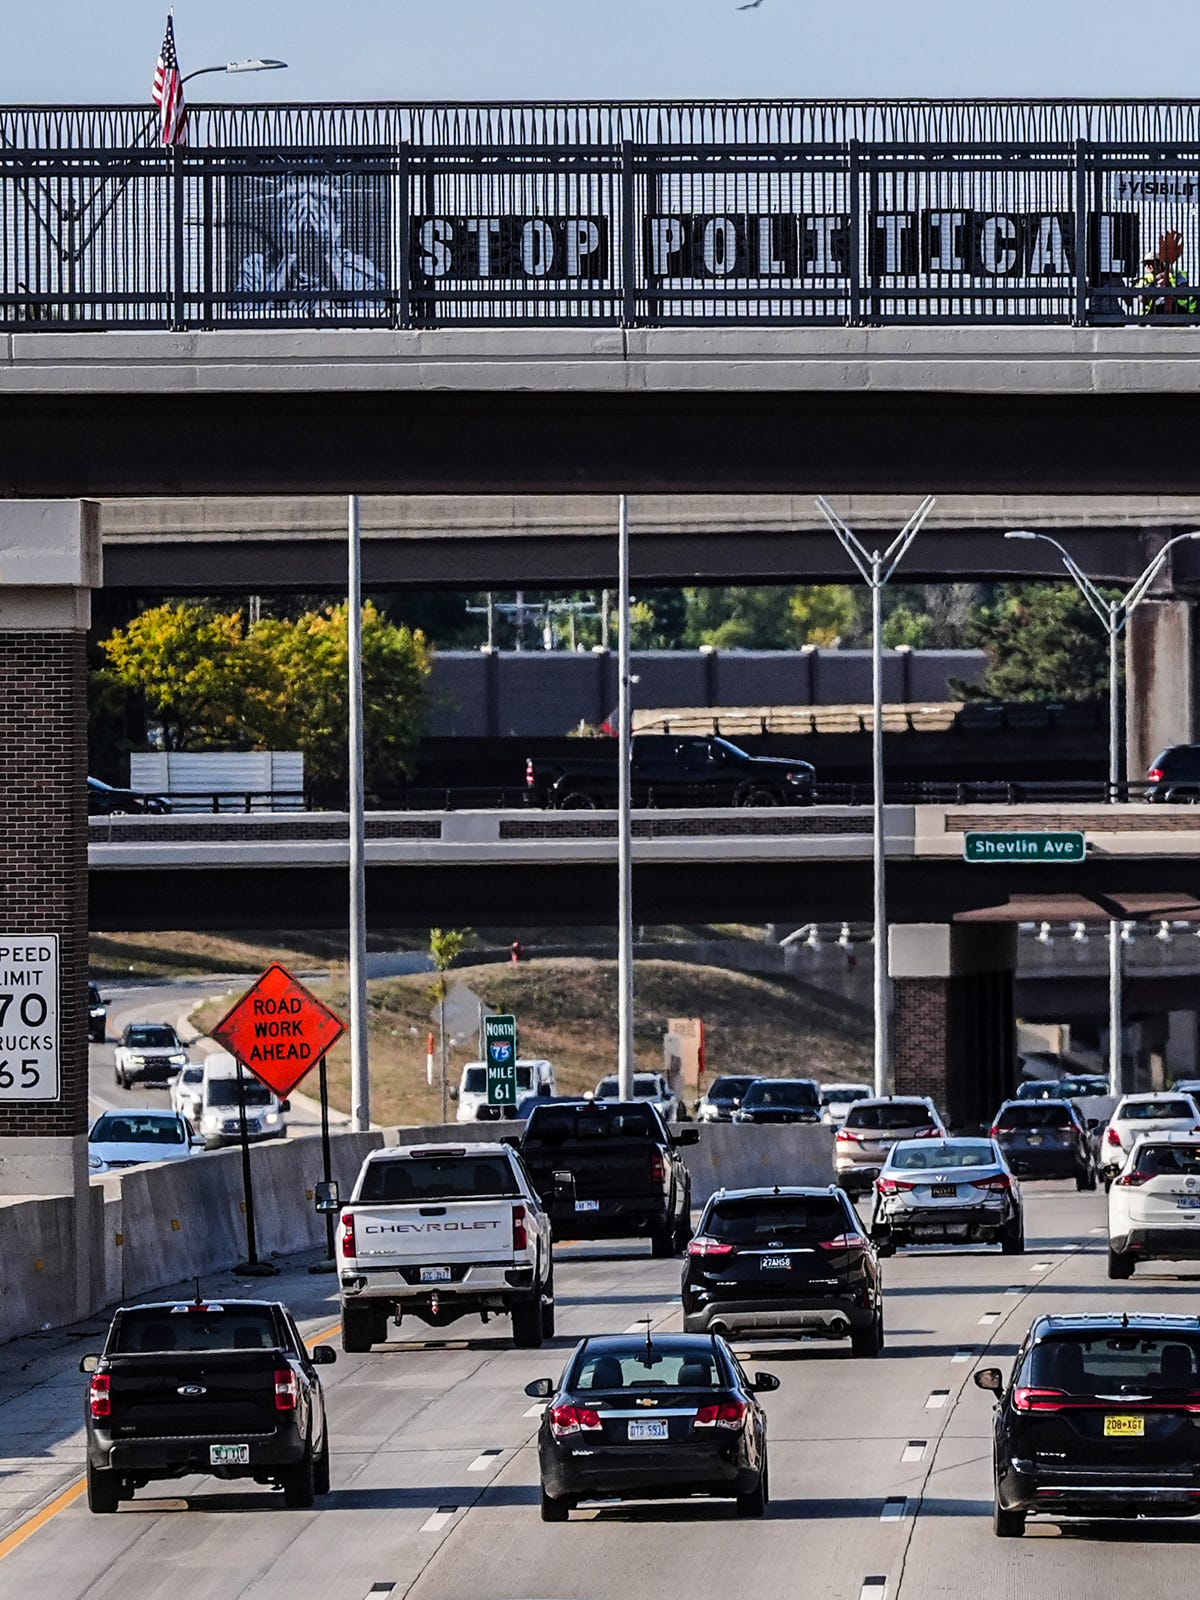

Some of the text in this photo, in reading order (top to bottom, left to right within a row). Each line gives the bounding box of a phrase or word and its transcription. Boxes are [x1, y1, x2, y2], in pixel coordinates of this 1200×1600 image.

[418, 218, 599, 277] STOP
[975, 839, 1075, 854] Shevlin Ave
[0, 947, 51, 962] PEED
[0, 970, 43, 986] IMIT
[0, 992, 48, 1028] 70
[253, 998, 302, 1015] ROAD
[254, 1020, 304, 1038] WORK
[486, 1023, 514, 1037] NORTH
[0, 1035, 53, 1051] UCKS
[249, 1042, 312, 1061] AHEAD
[492, 1046, 509, 1058] 75
[0, 1059, 40, 1089] 65
[488, 1067, 514, 1079] MILE
[494, 1084, 510, 1100] 61
[365, 1220, 501, 1234] CHEVROLET
